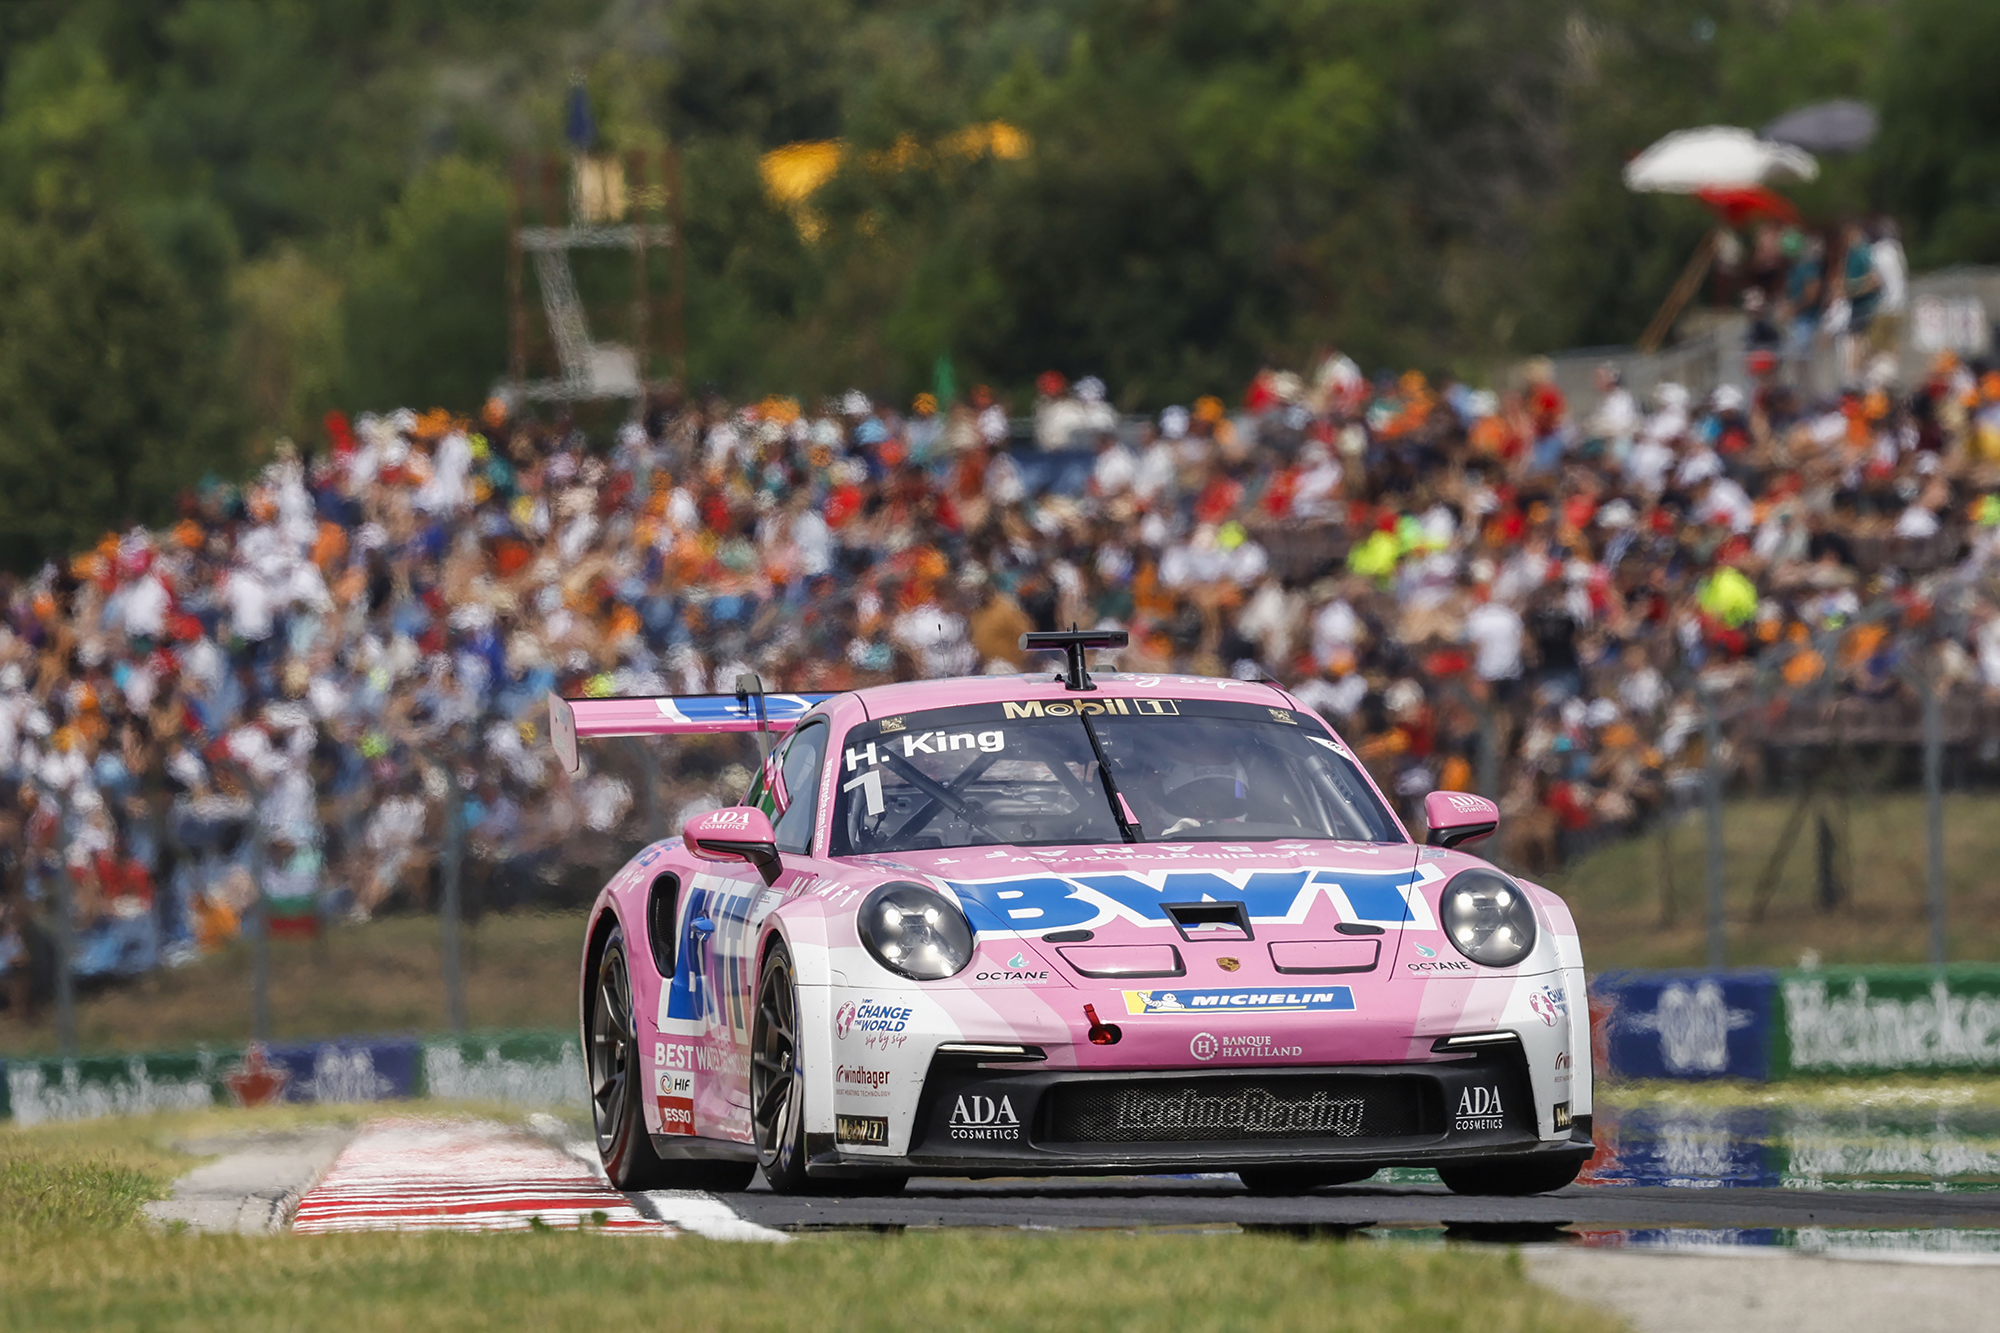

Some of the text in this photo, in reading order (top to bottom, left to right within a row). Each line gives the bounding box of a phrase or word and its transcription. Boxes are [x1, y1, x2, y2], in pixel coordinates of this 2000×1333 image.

[1002, 698, 1129, 719] Mobil
[846, 730, 1005, 772] H. King
[843, 769, 885, 816] 1
[1447, 796, 1487, 807] ADA
[703, 812, 750, 823] ADA
[940, 866, 1430, 936] BWT
[1407, 961, 1471, 971] OCTANE
[976, 971, 1049, 980] OCTANE
[1191, 993, 1334, 1006] MICHELIN
[857, 1005, 913, 1020] CHANGE
[861, 1020, 905, 1032] WORLD
[1222, 1036, 1271, 1046] BANQUE
[655, 1042, 694, 1069] BEST
[1222, 1046, 1302, 1057] HAVILLAND
[843, 1065, 890, 1089] windhager
[674, 1079, 690, 1091] HIF
[1456, 1085, 1504, 1115] ADA
[664, 1107, 691, 1123] ESSO
[949, 1094, 1020, 1124] ADA
[838, 1118, 868, 1140] Mobil
[1455, 1119, 1503, 1130] COSMETICS
[951, 1129, 1019, 1140] COSMETICS
